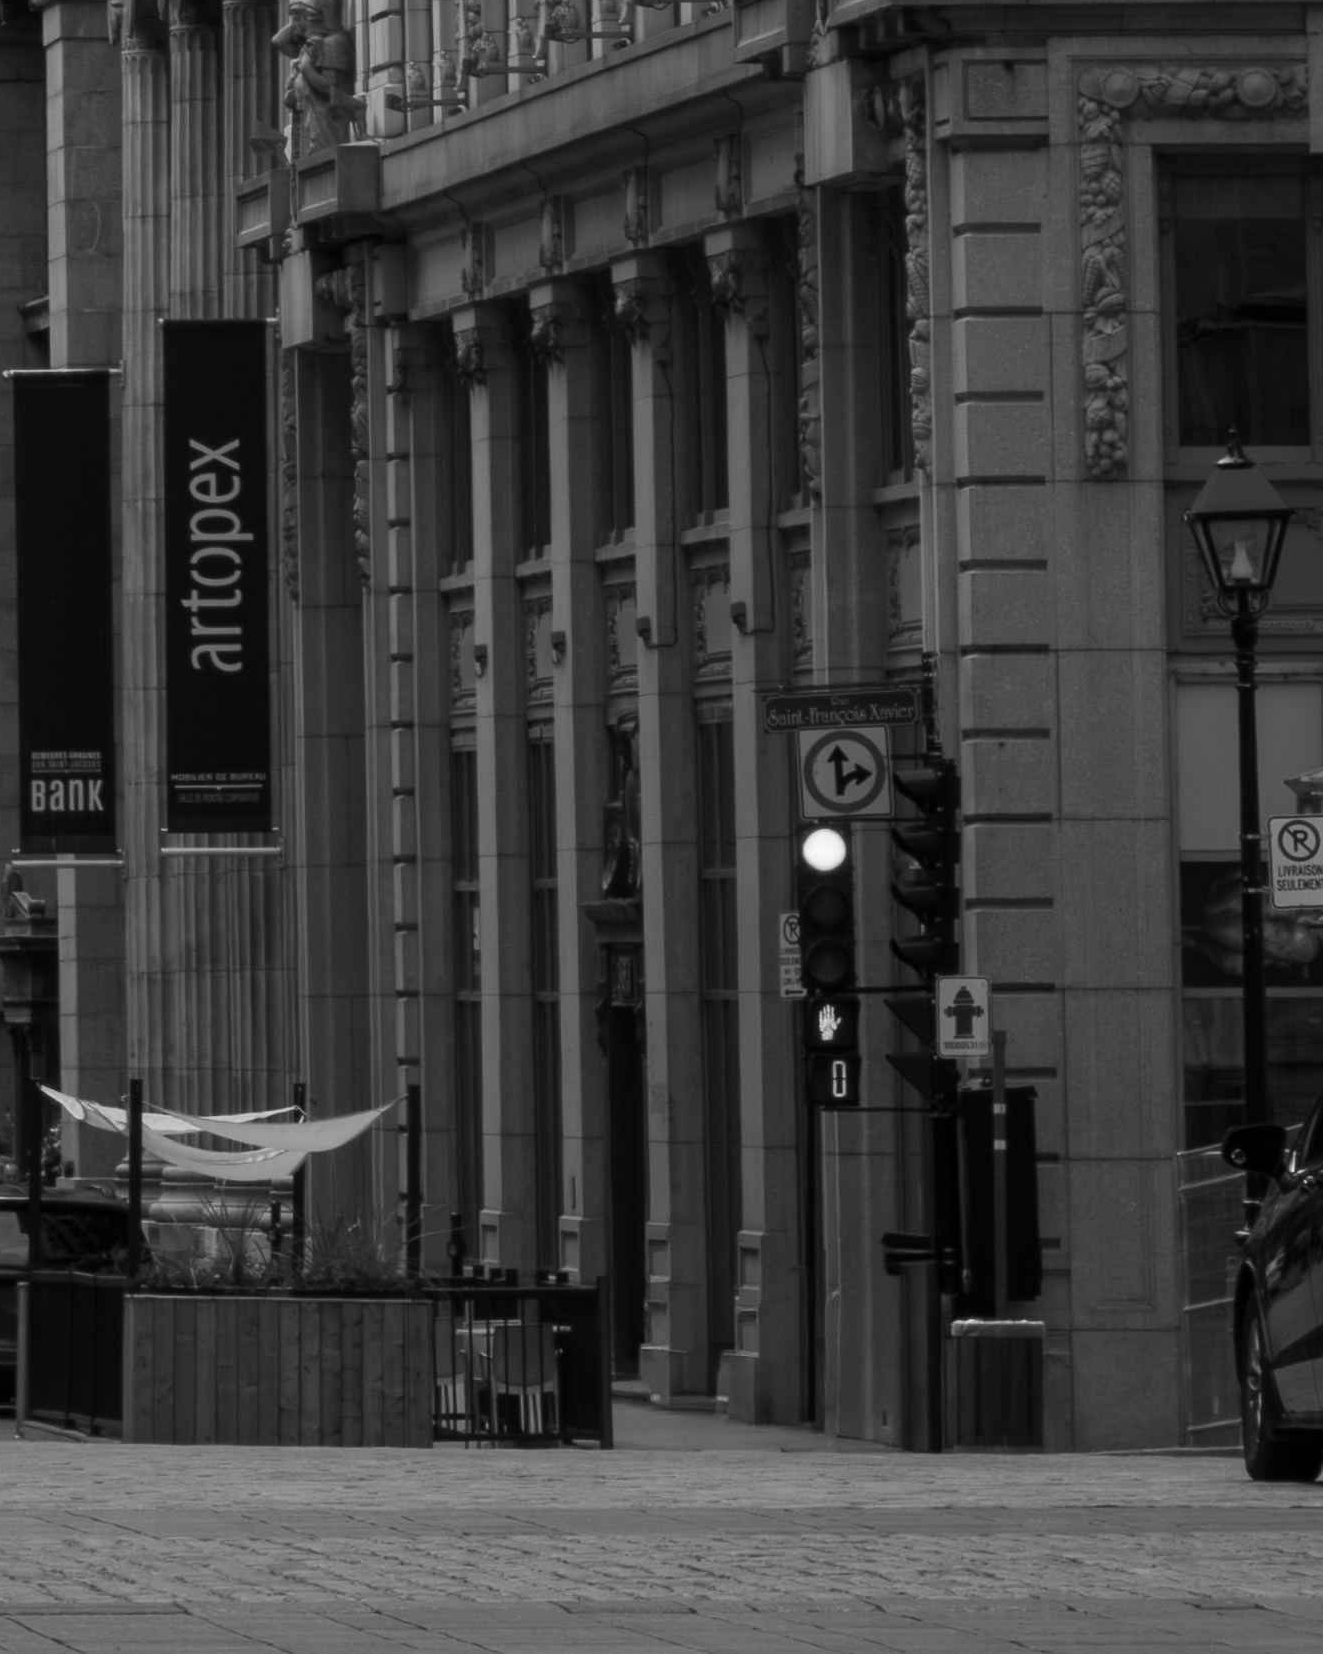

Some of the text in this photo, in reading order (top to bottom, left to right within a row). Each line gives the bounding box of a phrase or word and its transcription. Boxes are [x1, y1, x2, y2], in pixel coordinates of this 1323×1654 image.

[180, 438, 254, 672] artopex
[830, 696, 850, 706] Rue
[869, 703, 914, 721] Xavier
[832, 1060, 847, 1098] 0
